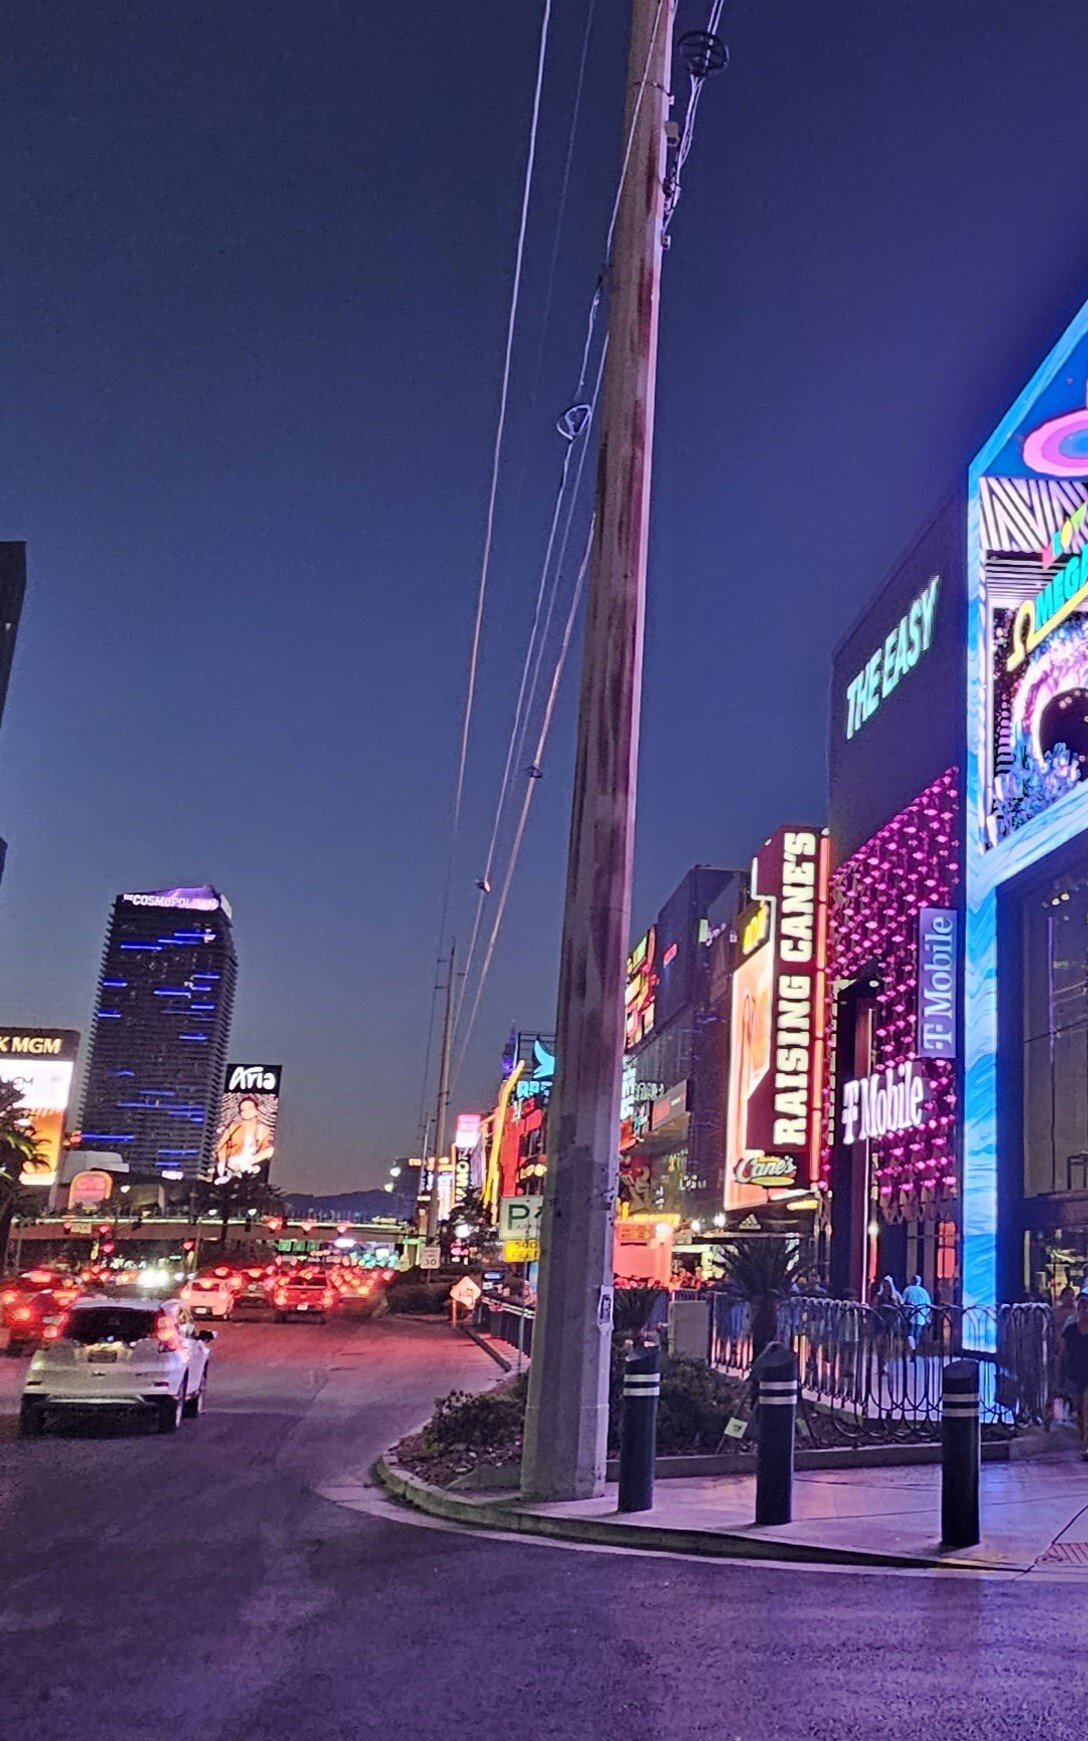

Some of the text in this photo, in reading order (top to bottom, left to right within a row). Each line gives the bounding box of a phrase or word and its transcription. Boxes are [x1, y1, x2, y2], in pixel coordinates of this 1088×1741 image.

[847, 575, 940, 740] THE EASY
[131, 894, 219, 911] COSMOPOL
[780, 831, 816, 963] CANE'S
[12, 1036, 62, 1054] MGM
[773, 974, 811, 1146] RAISING
[229, 1066, 276, 1091] Aria
[735, 1155, 797, 1183] Cane's
